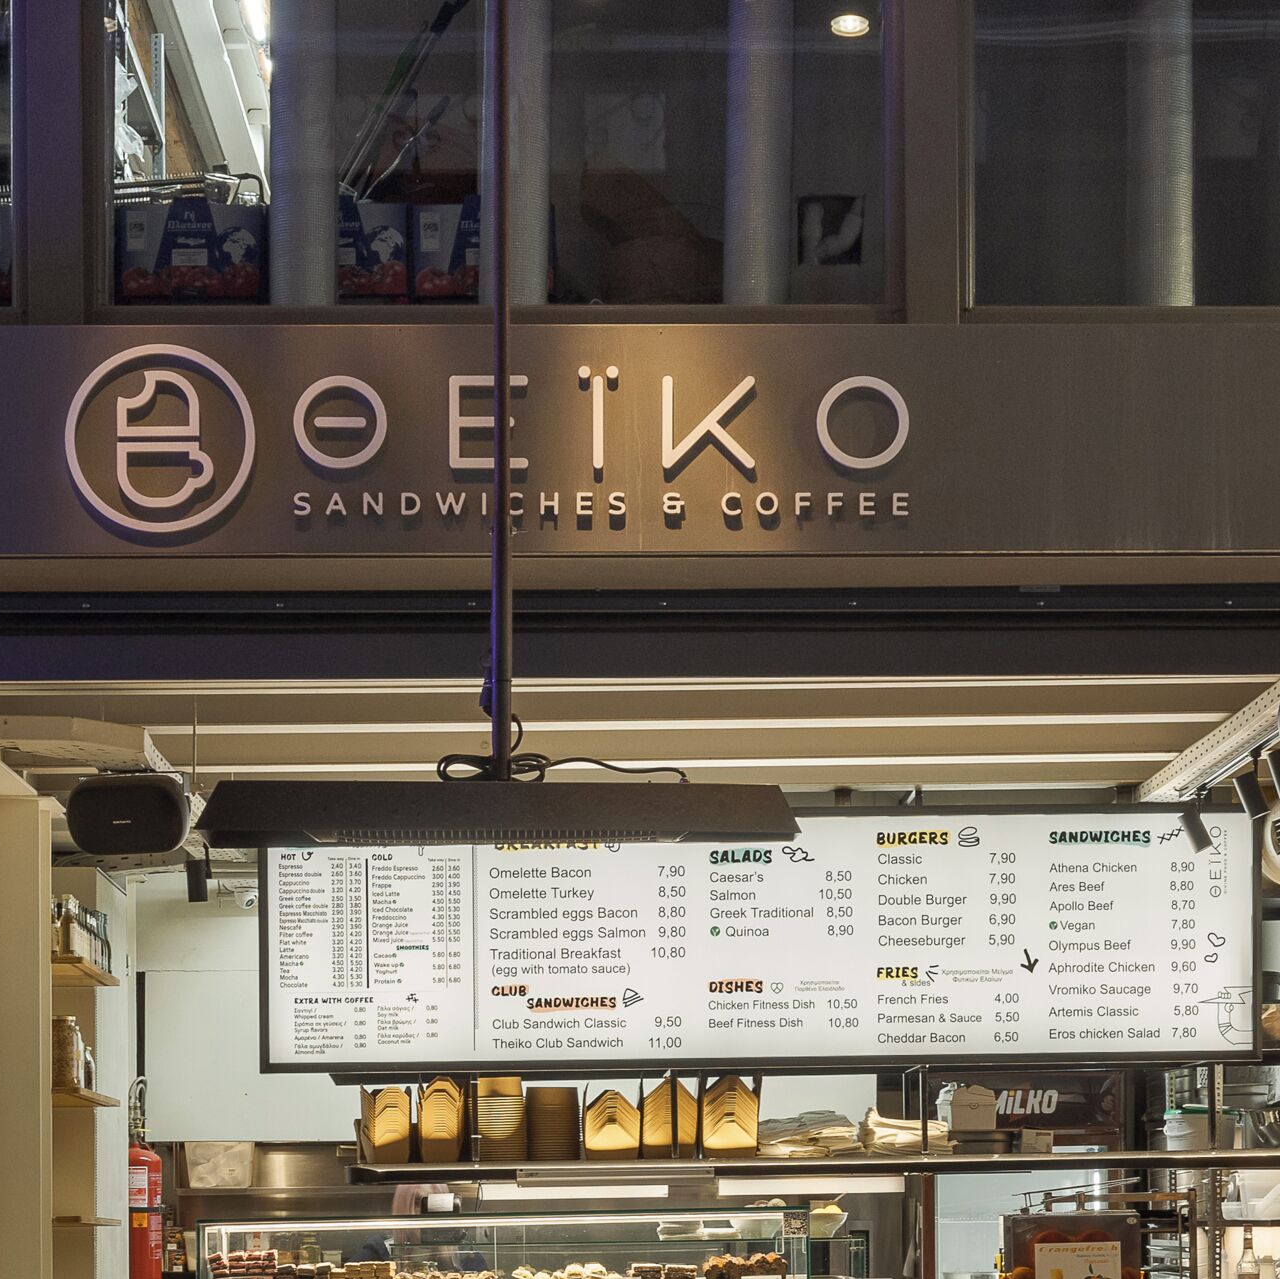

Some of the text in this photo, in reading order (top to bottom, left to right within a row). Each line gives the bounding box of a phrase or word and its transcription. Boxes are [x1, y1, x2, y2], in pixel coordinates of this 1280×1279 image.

[293, 492, 909, 516] SANDWICHES & COFFEE
[877, 832, 949, 846] BURGERS
[1049, 830, 1151, 844] SANDWICHES
[372, 853, 393, 861] COLD
[710, 849, 772, 864] SALADS
[878, 852, 1016, 865] Classic 7,90
[489, 865, 686, 879] Omelette Bacon 7,90
[1049, 861, 1195, 874] Athena Chicken 8,90
[710, 870, 852, 883] Caesar's 8,50
[878, 872, 1016, 886] Chicken 7,90
[489, 885, 686, 901] Omelette Turkey 8,50
[1049, 880, 1194, 892] Ares Beef 8,80
[710, 888, 852, 901] Salmon 10,50
[878, 893, 1017, 908] Double Burger 9,90
[710, 906, 853, 919] Greek Traditional 8,50
[1049, 899, 1196, 914] Apollo Beef 8,70
[489, 906, 686, 922] Scrambled eggs Bacon 8,80
[878, 913, 1016, 929] Bacon Burger 6,90
[725, 924, 854, 938] Quinoa 8,90
[1060, 918, 1196, 933] Vegan 7,80
[490, 925, 686, 942] Scrambled eggs Salmon 9,80
[878, 933, 1015, 949] Cheeseburger 5,90
[1049, 938, 1196, 954] Olympus Beef 9,90
[489, 946, 686, 960] Traditional Breakfast 10,80
[492, 963, 631, 978] (egg with tomato sauce)
[877, 966, 918, 978] FRIES
[1048, 960, 1196, 976] Aphrodite Chicken 9,60
[491, 985, 528, 996] CLUB
[709, 980, 763, 993] DISHES
[1049, 983, 1199, 997] Vromiko Saucage 9,70
[526, 996, 616, 1009] SANDWICHES
[708, 998, 858, 1011] Chicken Fitness Dish 10,50
[878, 993, 1020, 1005] French Fries 4,00
[878, 1011, 1020, 1024] Parmesan & Sauce 5,50
[1048, 1005, 1199, 1018] Artemis Classic 5,80
[492, 1016, 682, 1030] Club Sandwich Classic 9,50
[709, 1017, 859, 1029] Beef Fitness Dish 10,80
[877, 1031, 1019, 1045] Cheddar Bacon 6,50
[1050, 1027, 1197, 1039] Eros chicken Salad 7,80
[492, 1036, 682, 1050] Theiko Club Sandwich 11,00
